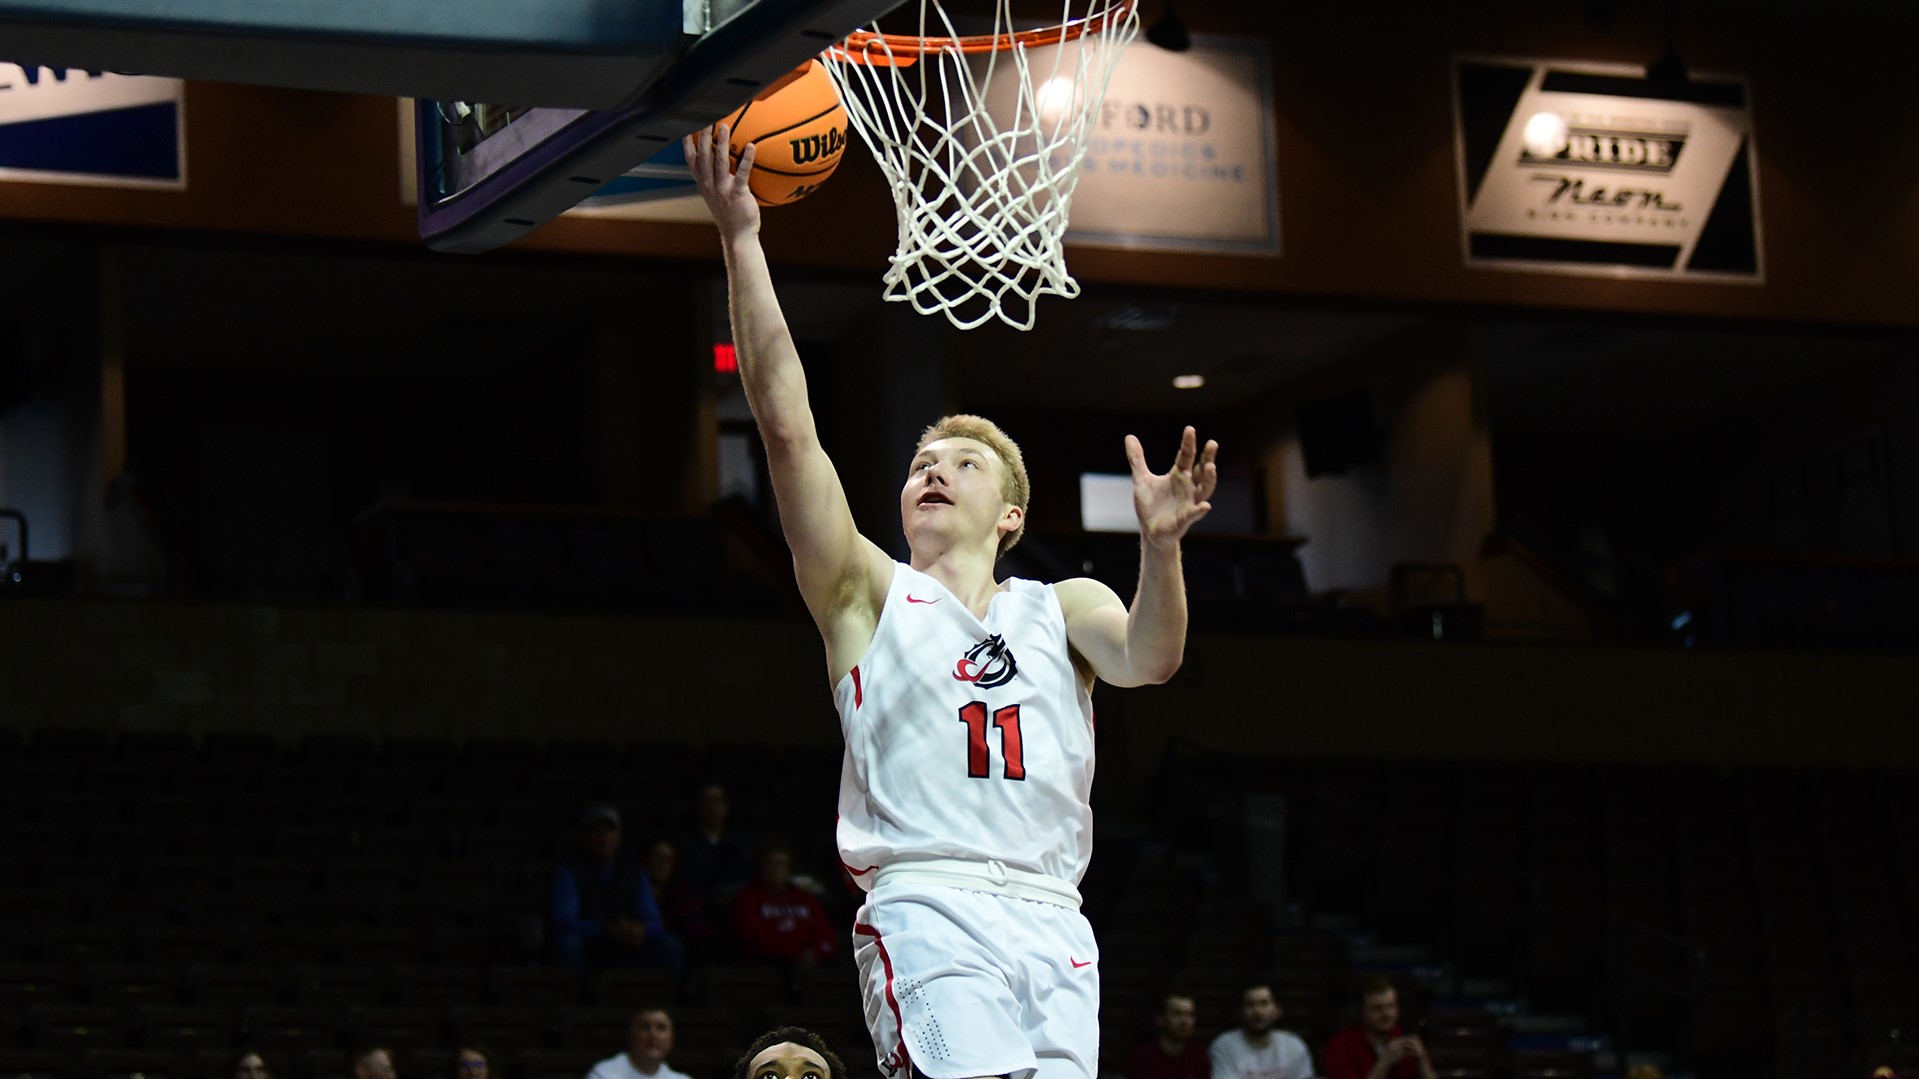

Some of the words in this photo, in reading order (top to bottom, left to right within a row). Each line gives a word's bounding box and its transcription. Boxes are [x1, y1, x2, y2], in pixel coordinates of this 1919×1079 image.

[789, 126, 848, 165] Wils
[1529, 131, 1674, 167] RIDE
[958, 700, 1026, 781] 11
